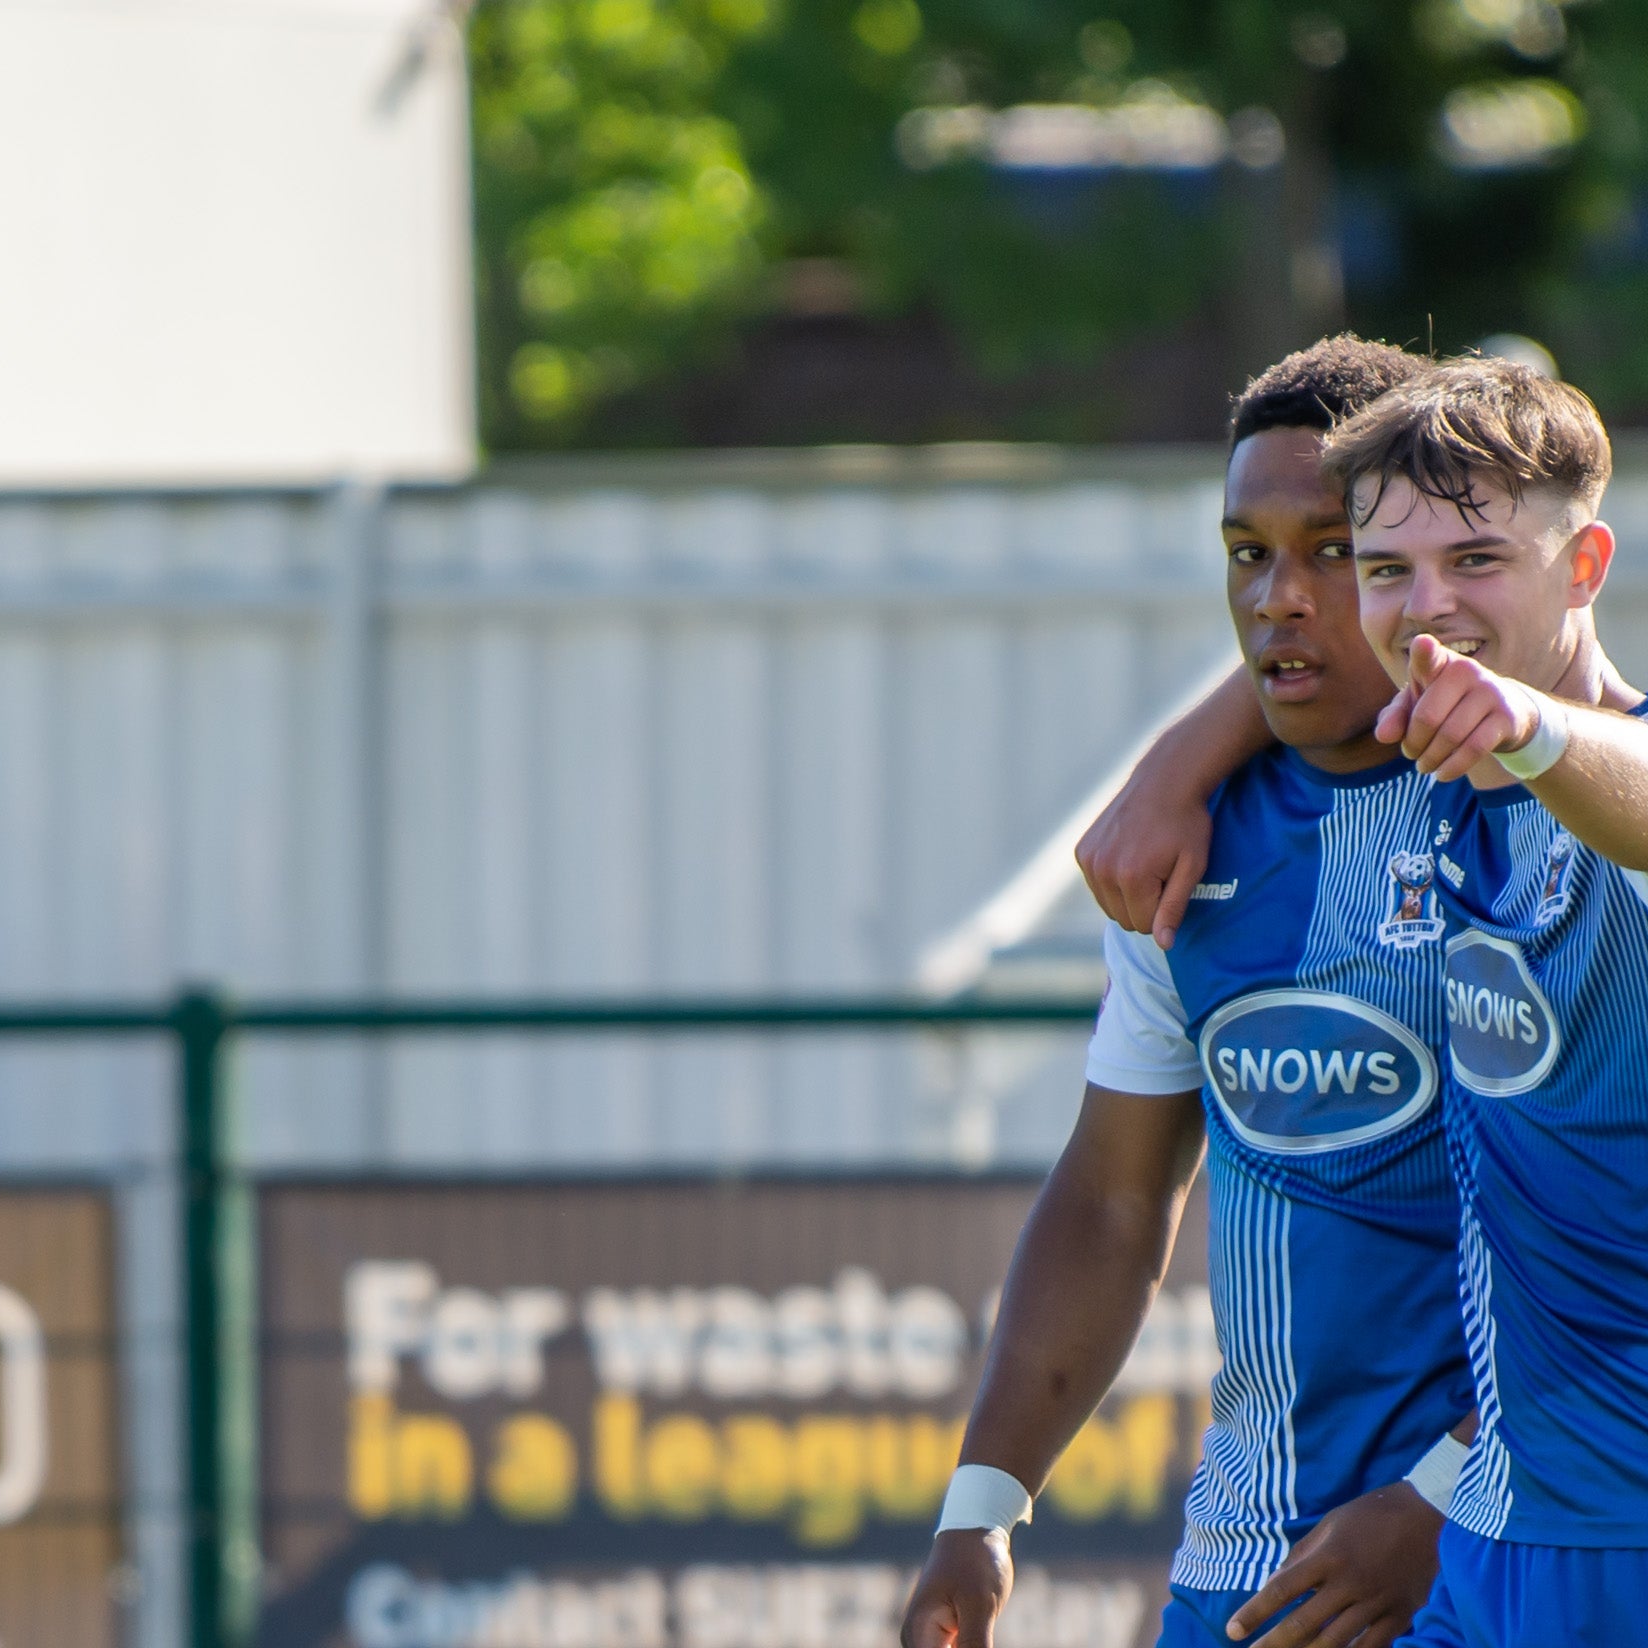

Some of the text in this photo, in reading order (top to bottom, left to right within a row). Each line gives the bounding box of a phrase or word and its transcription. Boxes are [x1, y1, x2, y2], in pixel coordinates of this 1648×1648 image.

[1445, 978, 1539, 1045] SNOWS
[1217, 1047, 1401, 1096] SNOWS
[347, 1260, 564, 1398] For
[582, 1270, 968, 1398] waste
[348, 1392, 474, 1520] in
[490, 1412, 578, 1520] a
